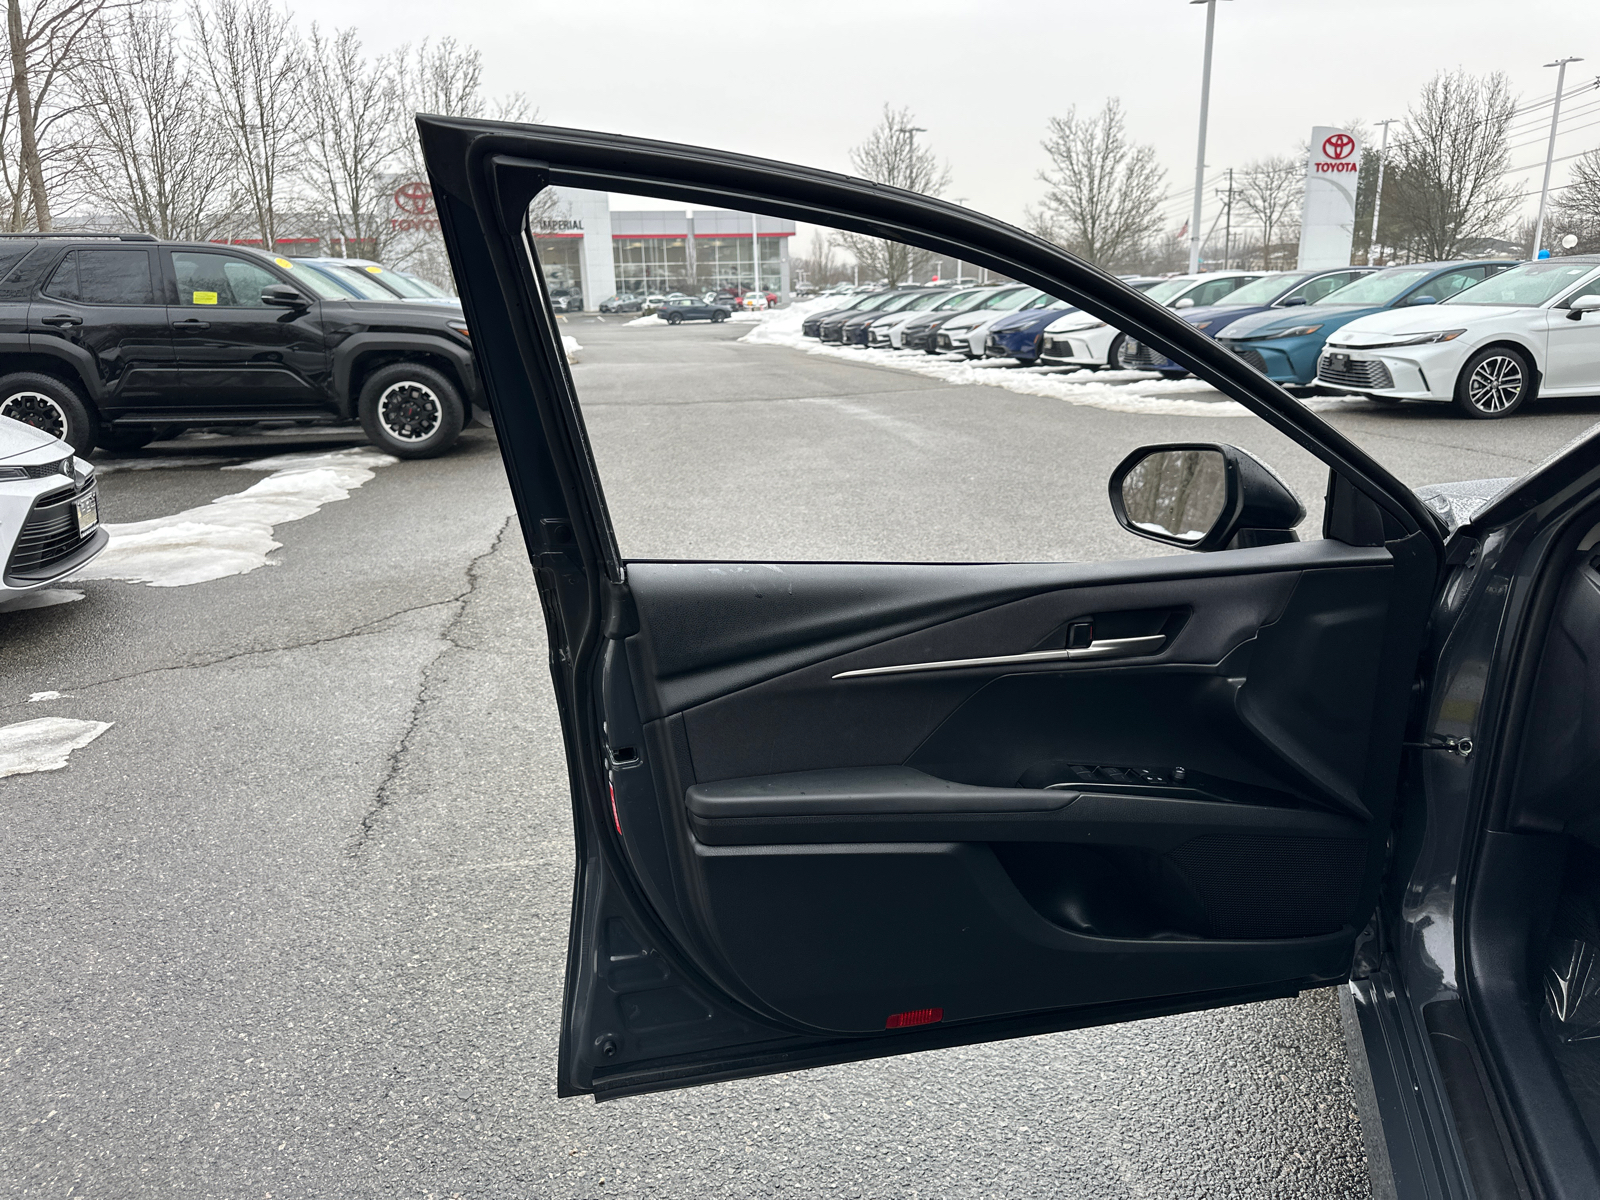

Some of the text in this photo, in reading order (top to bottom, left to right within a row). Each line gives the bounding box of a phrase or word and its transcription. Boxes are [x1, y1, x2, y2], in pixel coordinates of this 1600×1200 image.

[1314, 162, 1358, 173] TOYOTA
[390, 219, 442, 232] TOYOT
[540, 220, 585, 231] IMPERIAL
